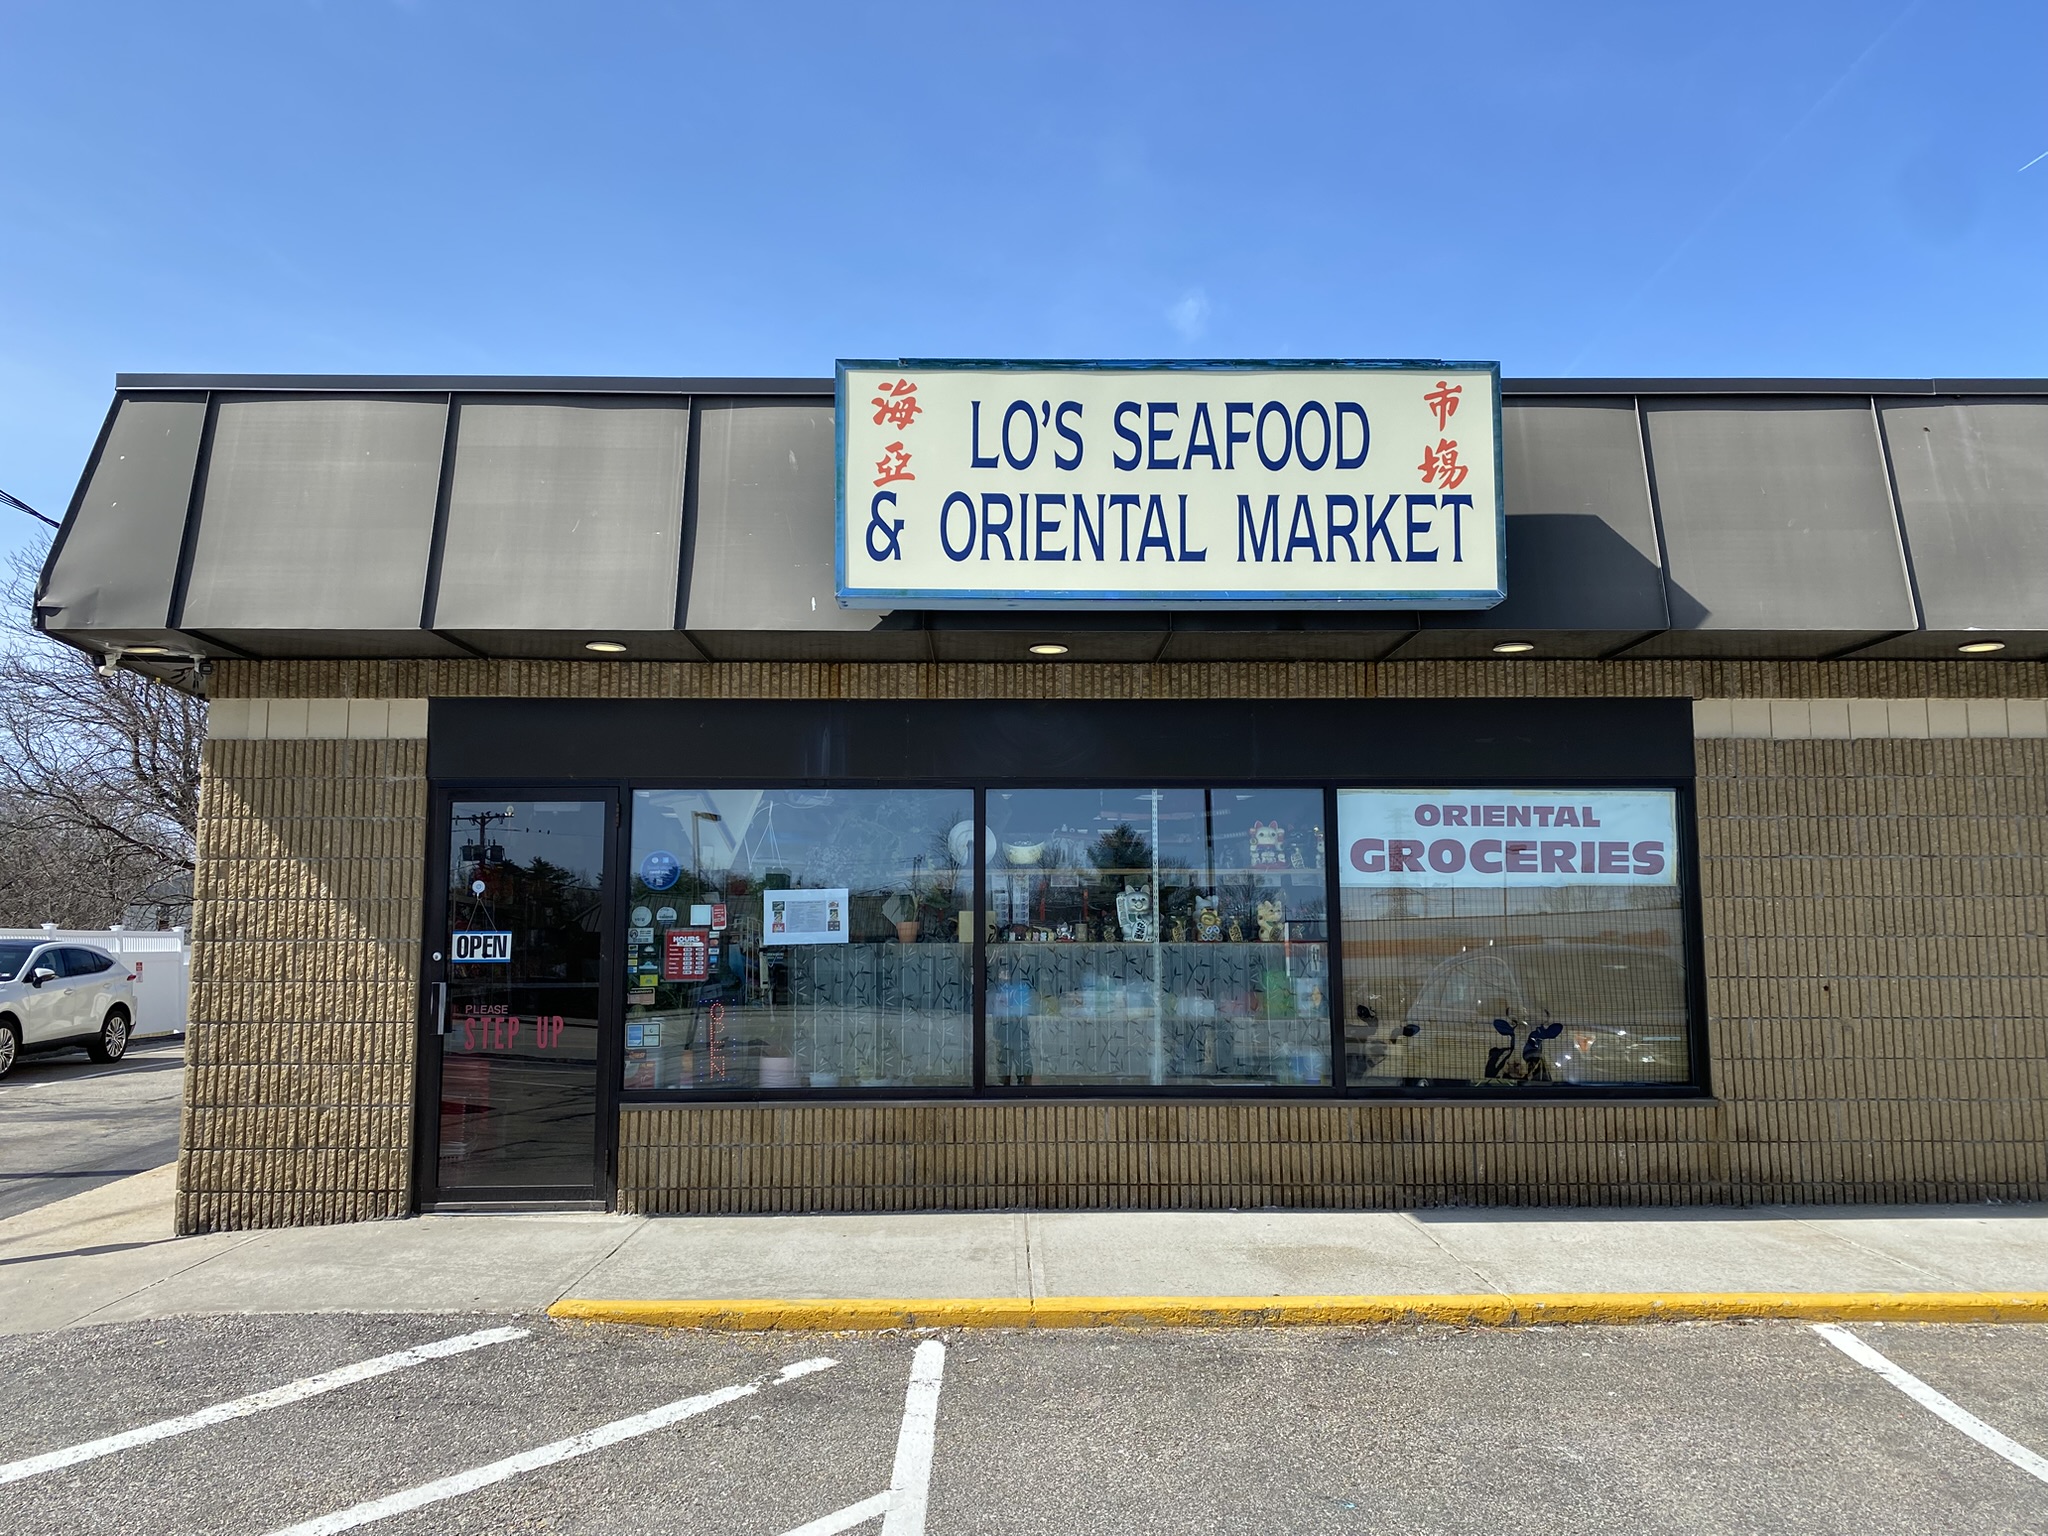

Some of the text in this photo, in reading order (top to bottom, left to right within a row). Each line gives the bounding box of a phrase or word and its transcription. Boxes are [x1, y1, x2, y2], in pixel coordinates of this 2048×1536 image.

[971, 400, 1370, 471] LO'S SEAFOOD
[866, 491, 1473, 562] & ORIENTAL MARKET
[1414, 804, 1601, 828] ORIENTAL
[1350, 838, 1666, 875] GROCERIES
[457, 935, 507, 958] OPEN
[672, 935, 701, 943] HOURS
[465, 1004, 509, 1015] PLEASE
[464, 1015, 564, 1050] STEP UP
[709, 1002, 726, 1080] OPEN
